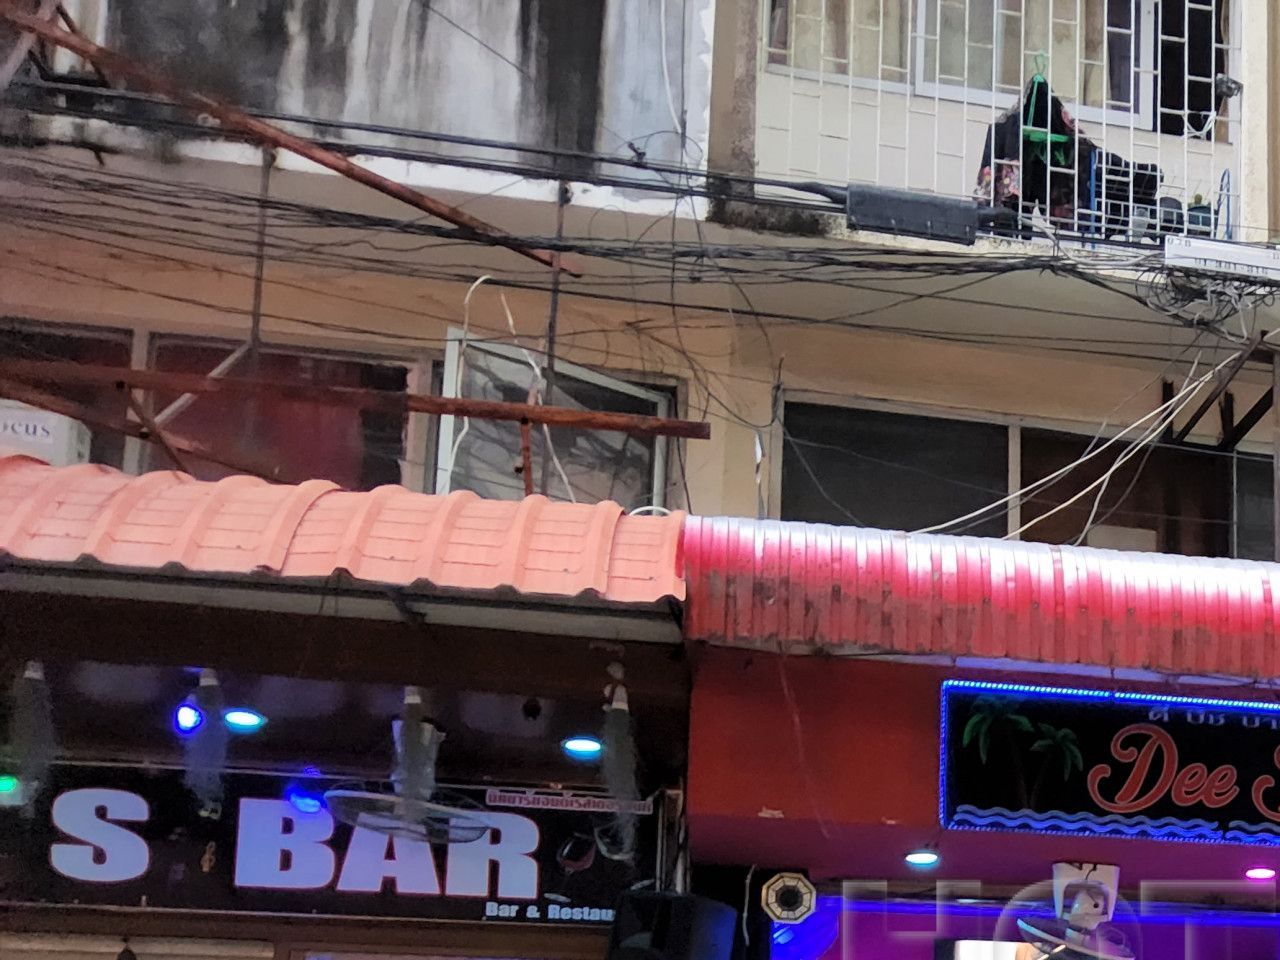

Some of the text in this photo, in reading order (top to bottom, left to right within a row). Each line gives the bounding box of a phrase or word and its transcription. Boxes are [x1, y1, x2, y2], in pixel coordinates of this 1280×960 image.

[1088, 723, 1240, 814] Dee
[233, 796, 541, 900] BAR
[486, 901, 519, 917] Bar
